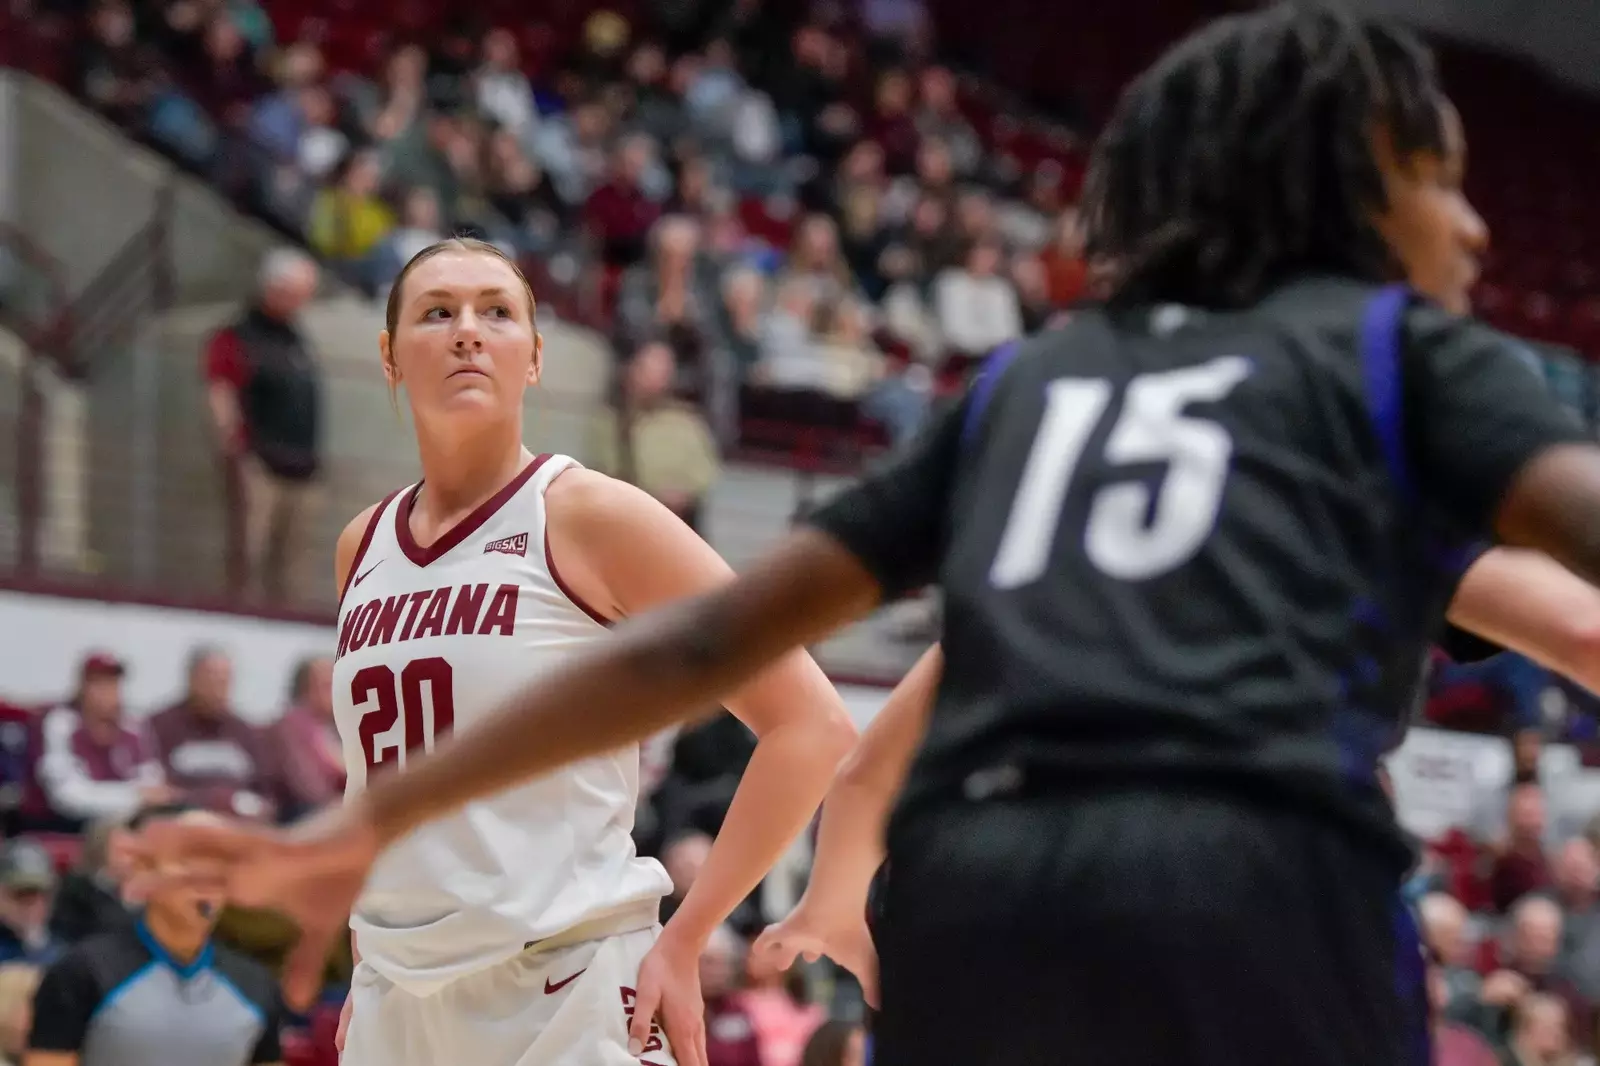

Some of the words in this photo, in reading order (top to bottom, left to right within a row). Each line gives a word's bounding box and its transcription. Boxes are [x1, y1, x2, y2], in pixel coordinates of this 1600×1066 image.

[988, 355, 1254, 590] 15
[334, 583, 520, 662] MONTANA
[351, 656, 455, 776] 20
